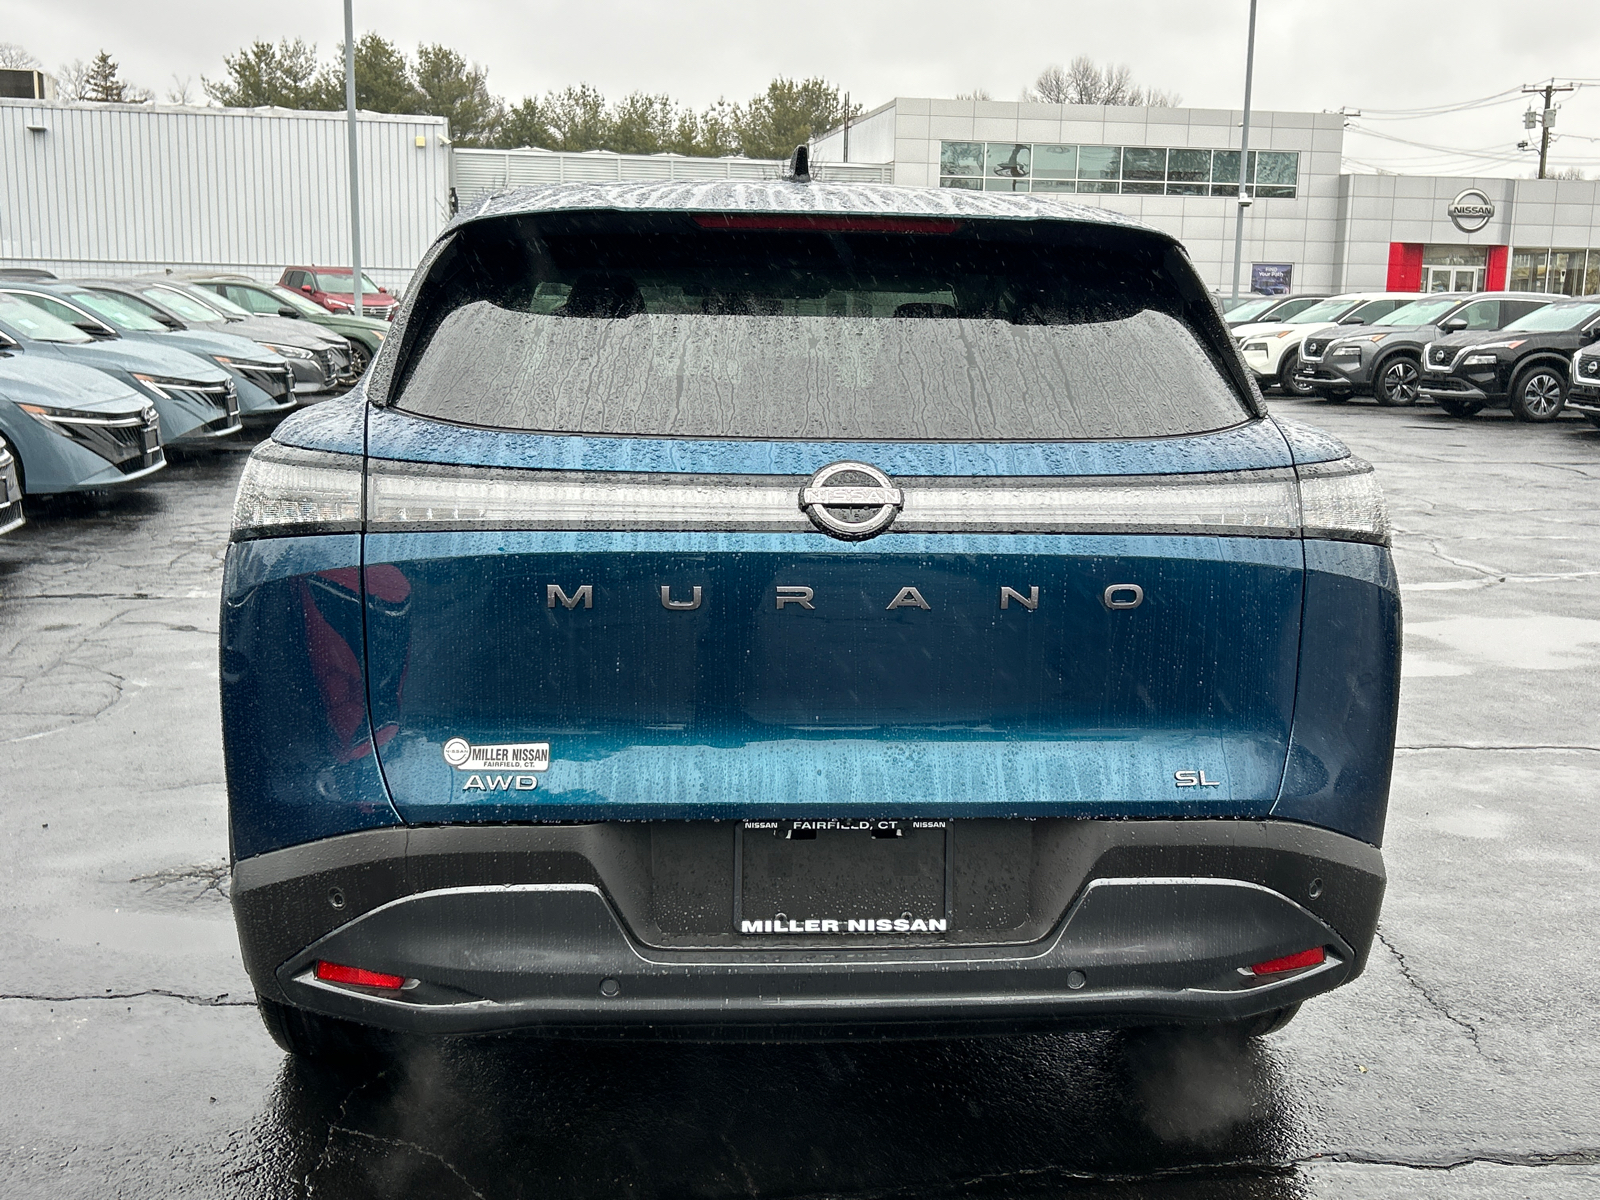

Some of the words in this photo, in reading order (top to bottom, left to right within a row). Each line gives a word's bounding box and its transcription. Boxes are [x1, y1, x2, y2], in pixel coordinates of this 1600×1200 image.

[1453, 206, 1492, 214] NISSAN
[806, 490, 899, 503] NISSAN
[547, 583, 1144, 610] MURANO
[472, 748, 509, 761] MILLER
[512, 748, 548, 761] NISSAN
[462, 775, 538, 792] AWD
[1174, 770, 1220, 787] SL
[878, 821, 898, 830] CT
[741, 920, 839, 932] MILLER
[848, 919, 947, 932] NISSAN
